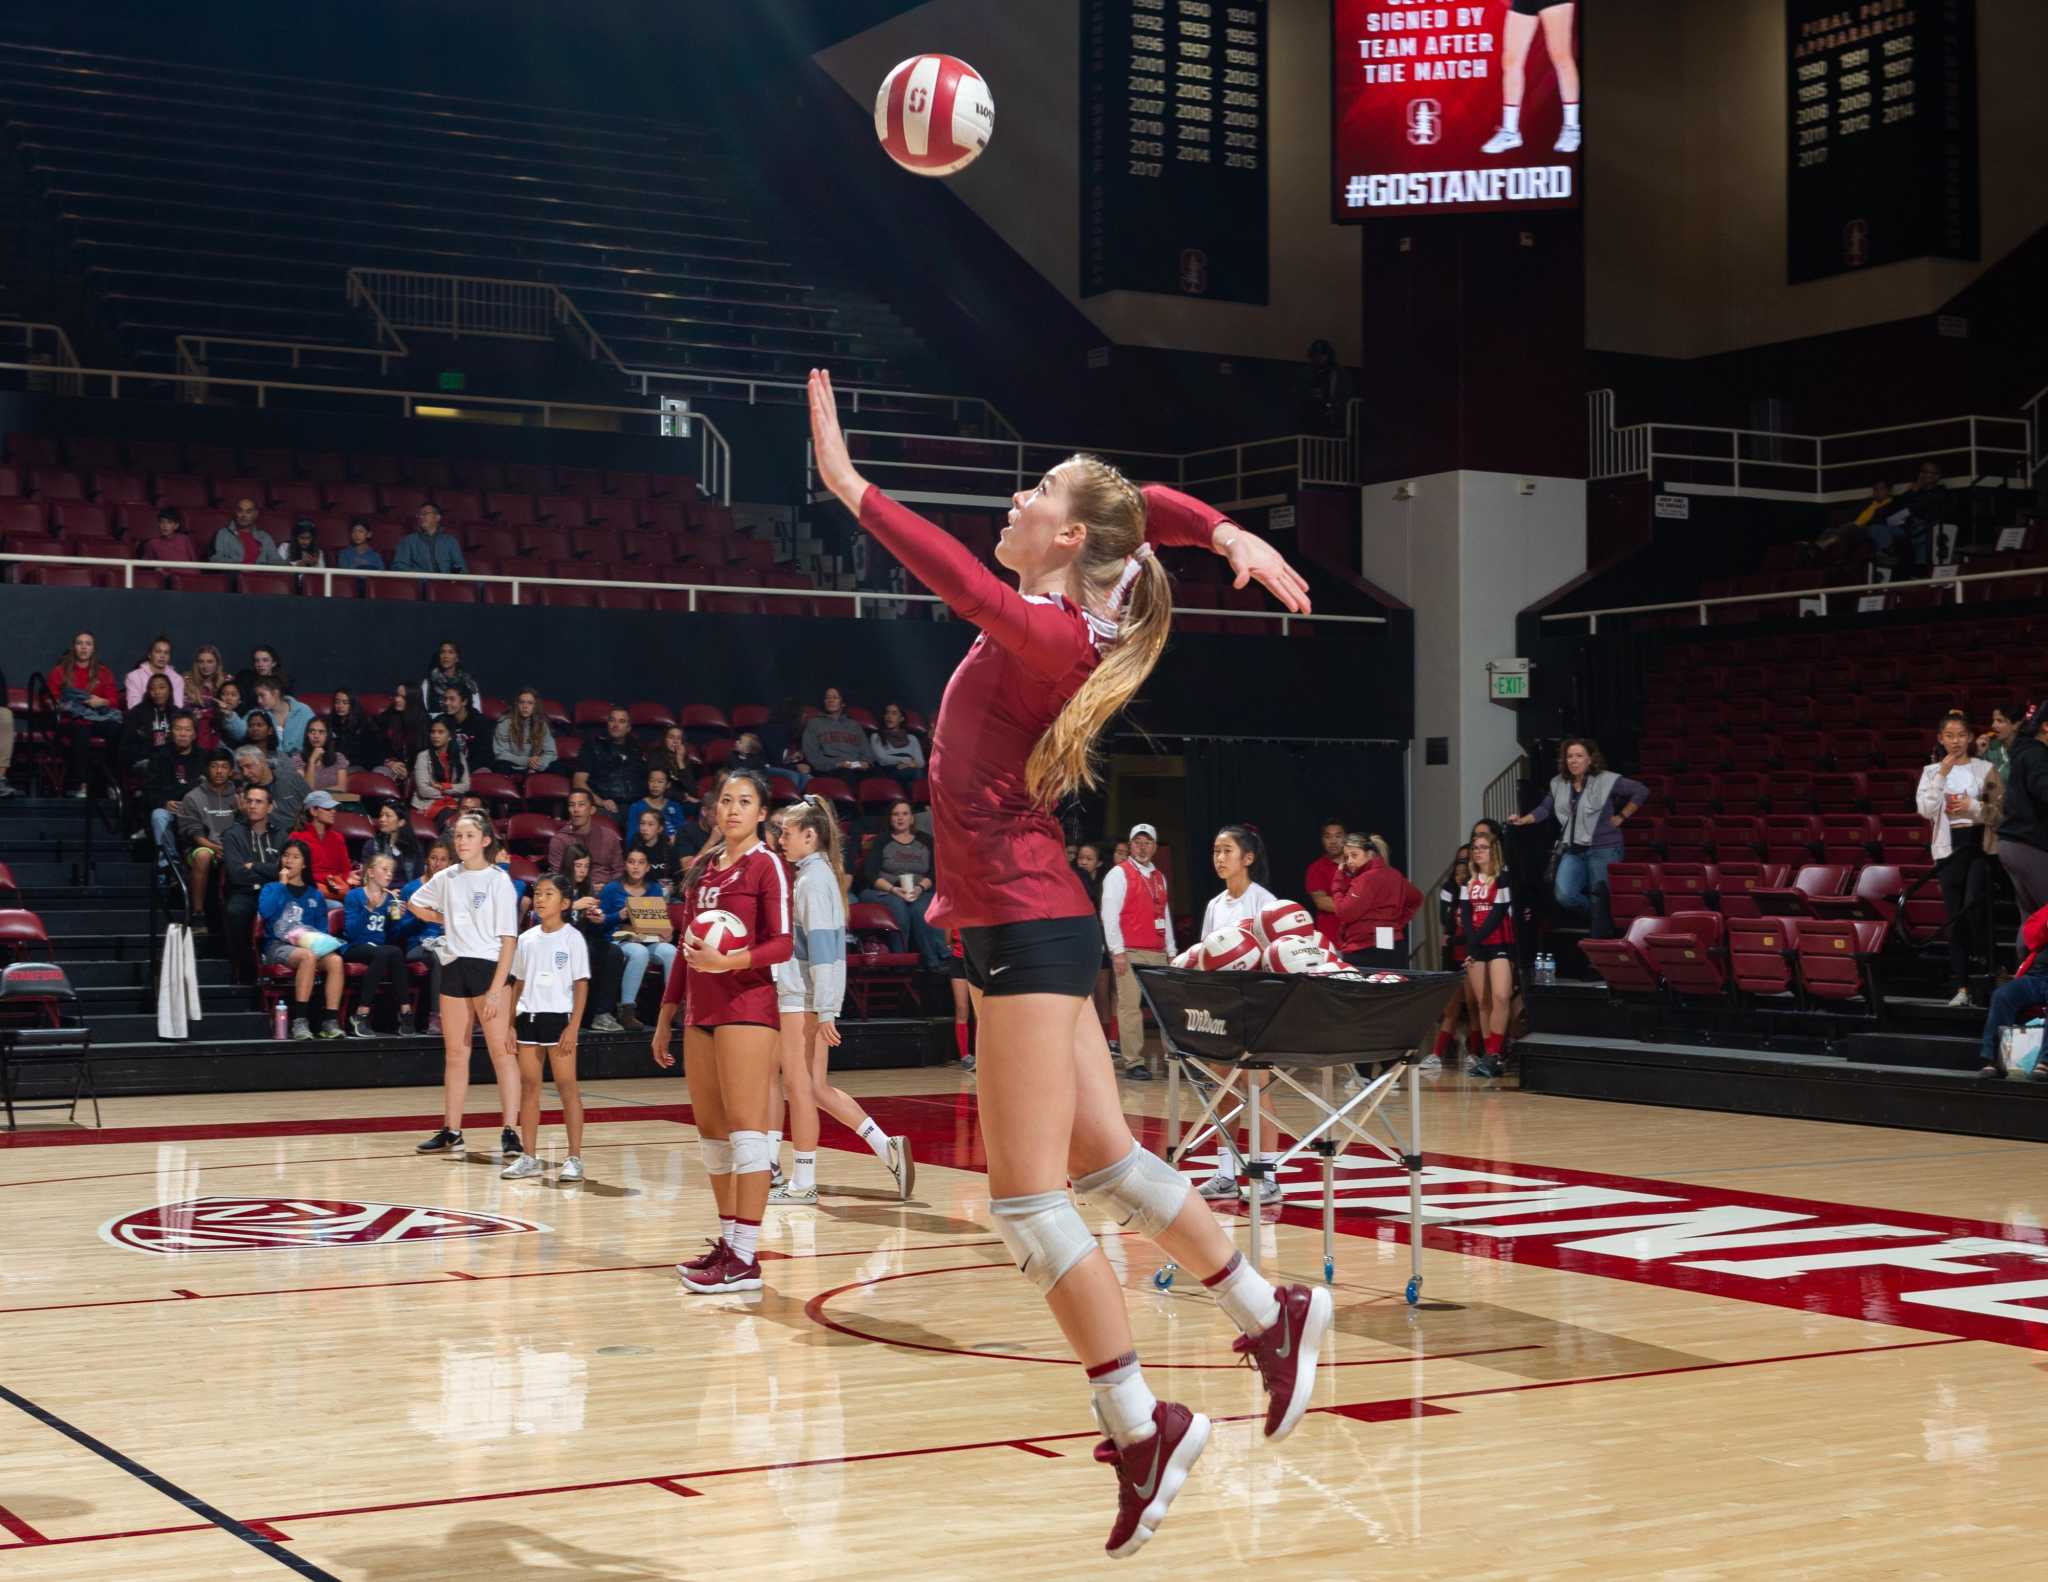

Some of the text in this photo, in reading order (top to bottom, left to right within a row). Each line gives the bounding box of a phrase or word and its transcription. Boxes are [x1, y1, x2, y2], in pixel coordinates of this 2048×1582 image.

[1366, 7, 1485, 32] SIGNED BY
[1358, 33, 1494, 59] TEAM AFTER
[1363, 58, 1488, 84] THE MATCH
[1345, 165, 1572, 208] #GOSTANFORD
[1497, 675, 1523, 695] EXIT
[366, 915, 386, 932] 32
[1184, 1008, 1227, 1036] Wilson
